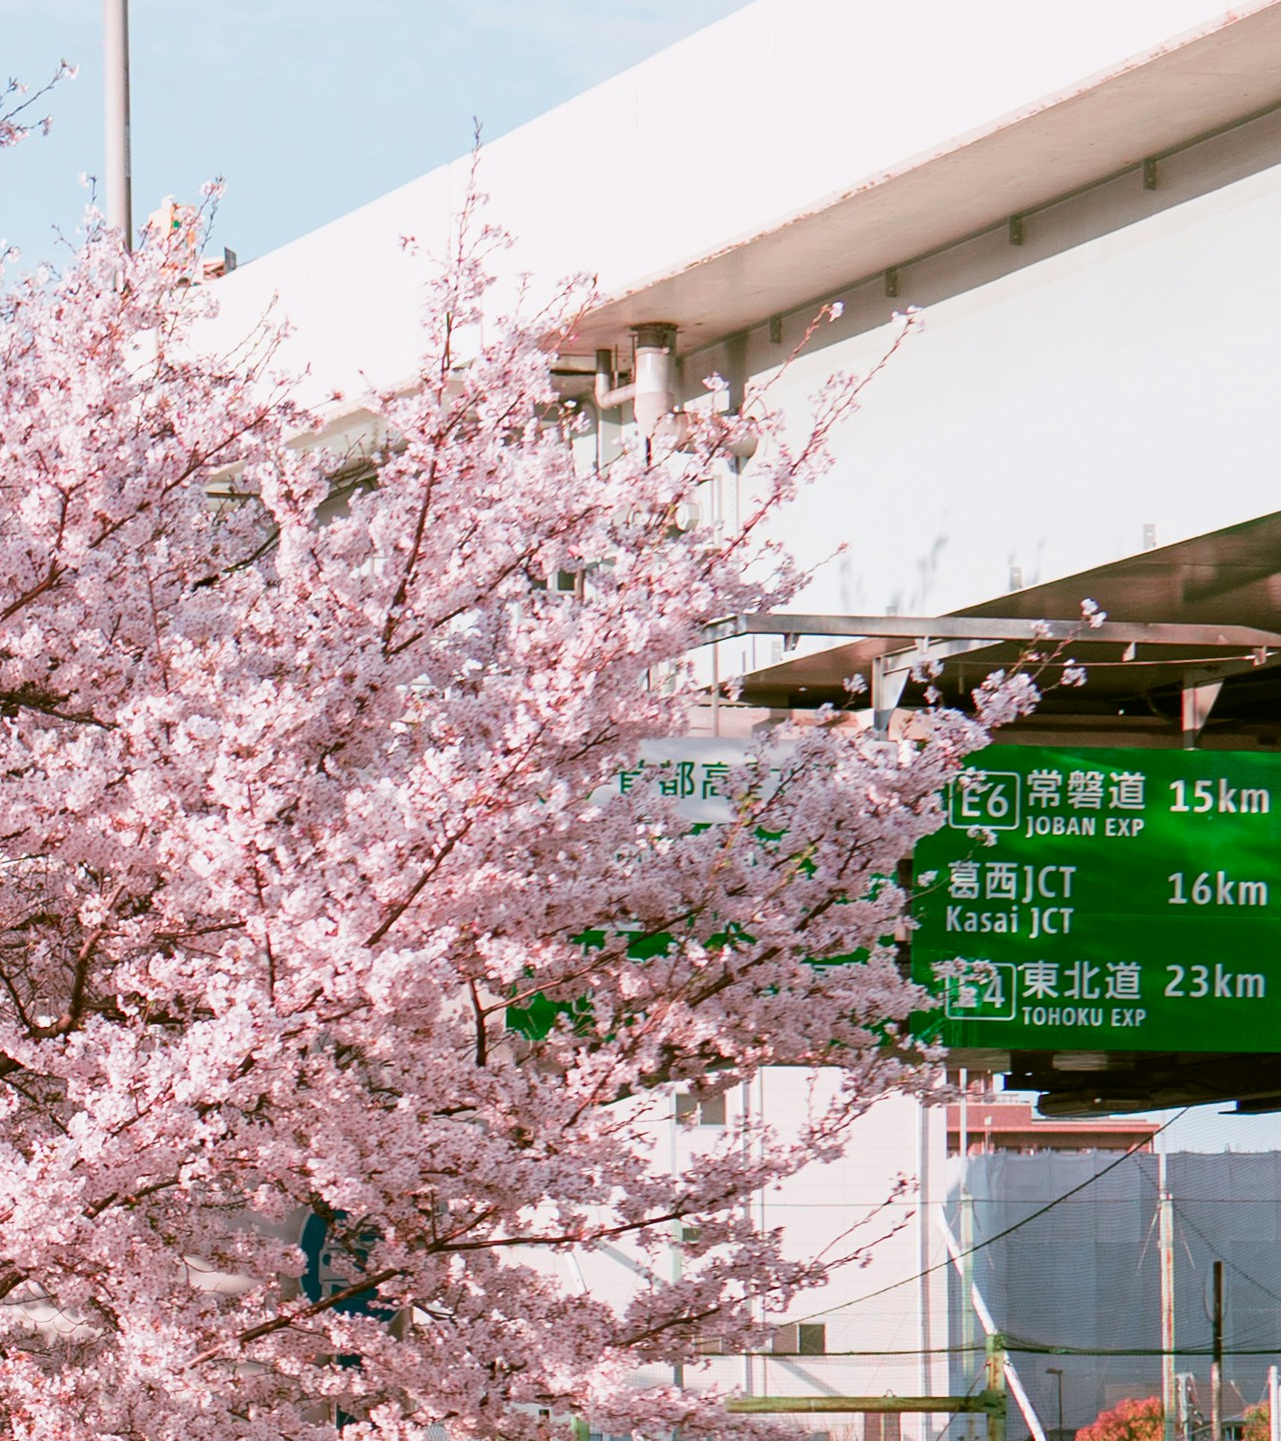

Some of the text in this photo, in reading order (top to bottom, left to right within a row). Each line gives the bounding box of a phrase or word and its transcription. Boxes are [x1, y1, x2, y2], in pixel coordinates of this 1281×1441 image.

[960, 769, 1271, 818] E6 常磐道 15km
[1025, 816, 1145, 838] JOBAN EXP
[947, 860, 1268, 906] 葛西JCT 16km
[945, 905, 1075, 939] Kasai JCT
[1022, 960, 1142, 1000] 東北道
[1163, 963, 1266, 999] 23km
[1021, 1006, 1147, 1027] TOHOKU EXP
